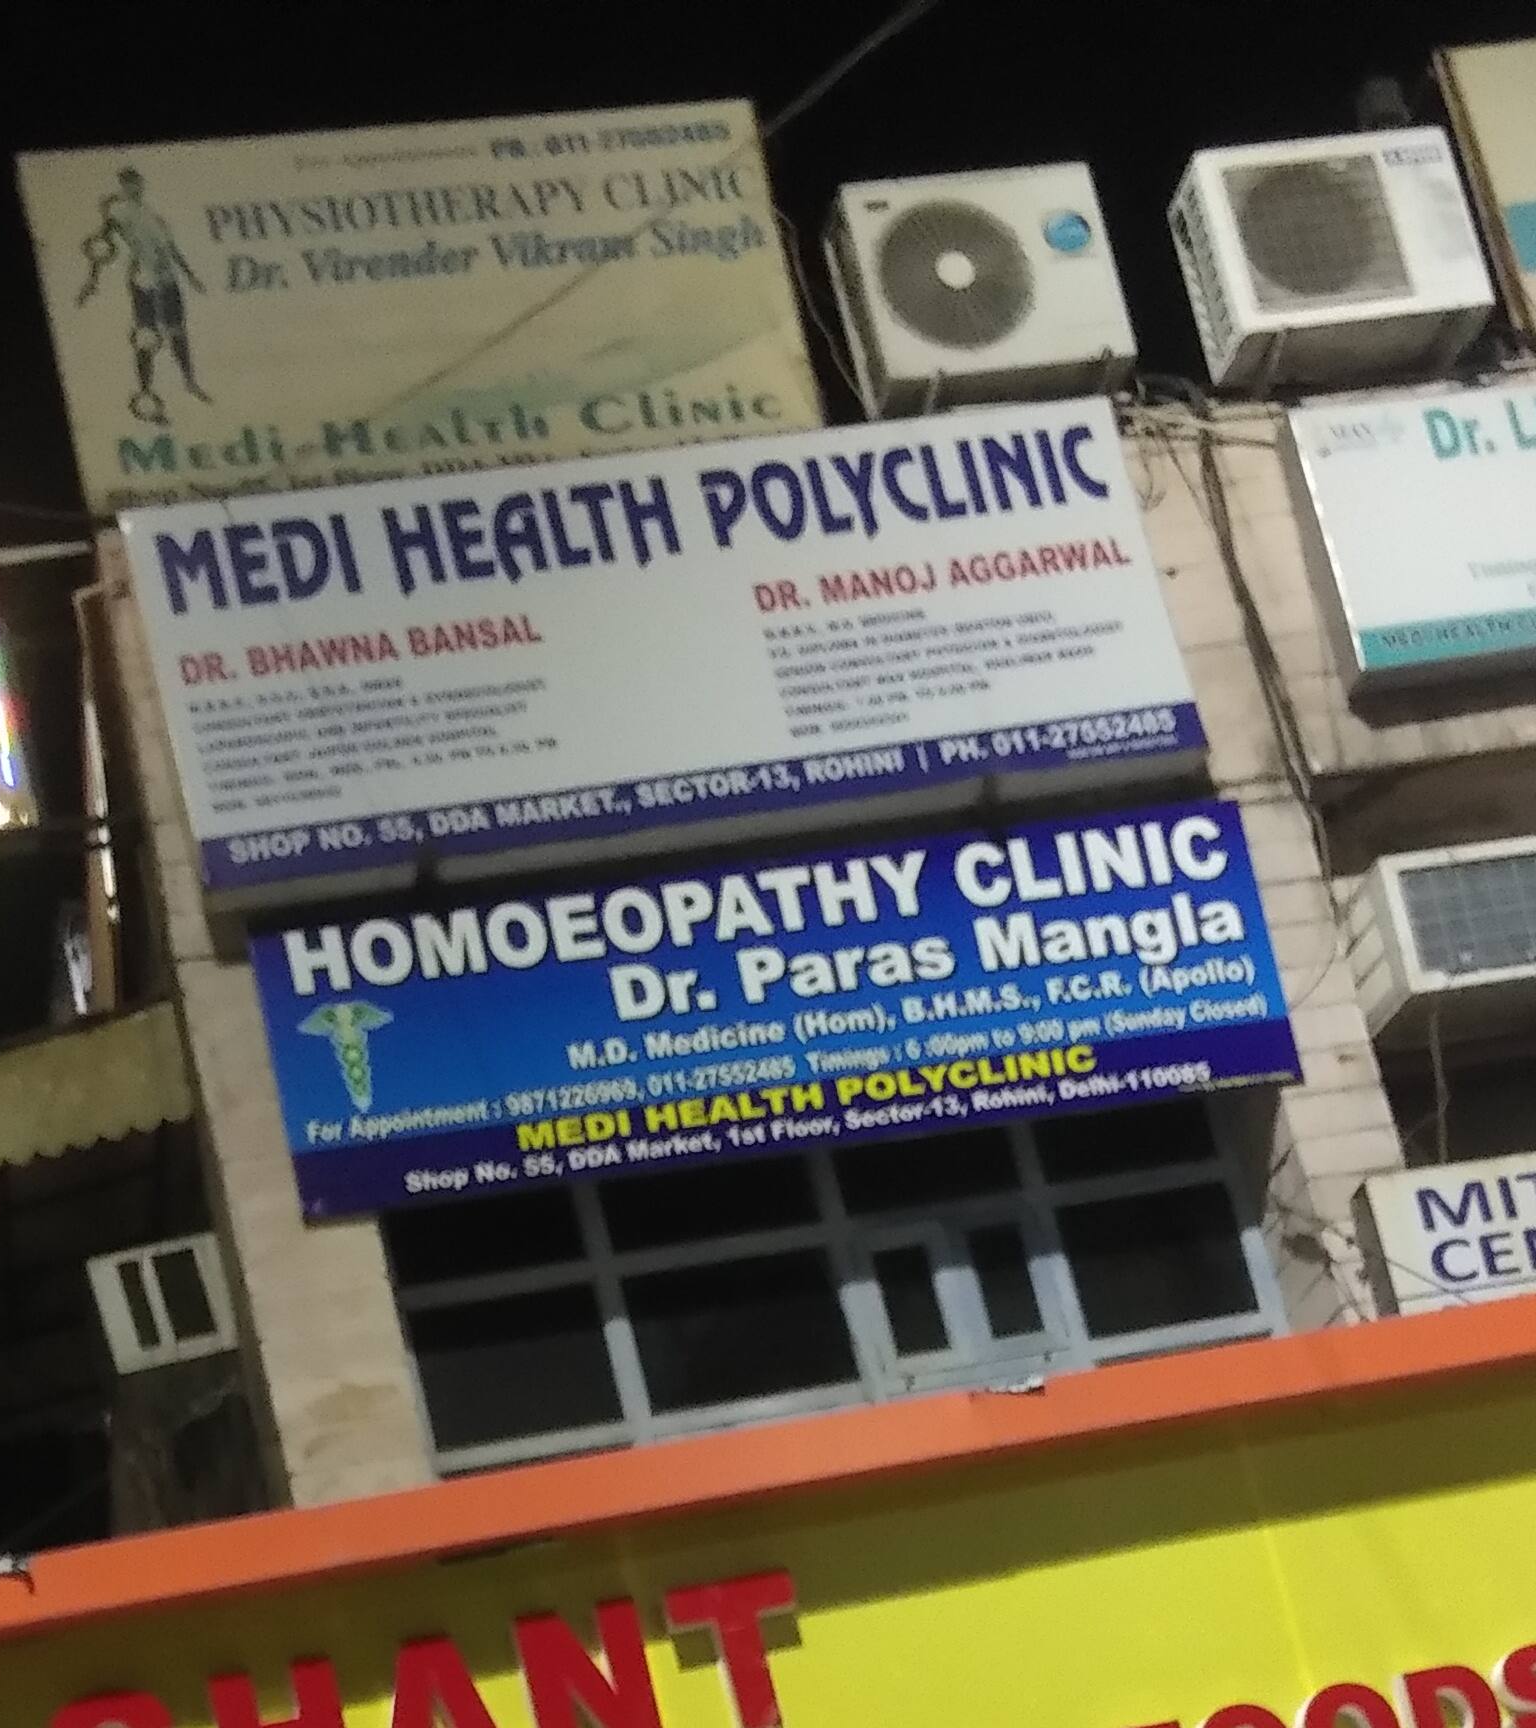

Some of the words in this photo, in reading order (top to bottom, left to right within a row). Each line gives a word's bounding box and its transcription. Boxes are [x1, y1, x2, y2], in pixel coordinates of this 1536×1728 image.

[205, 174, 586, 244] PHYSIOTHERAPY
[601, 164, 744, 209] CLINIC
[226, 253, 289, 294] Dr.
[301, 240, 479, 286] Virender
[490, 229, 637, 270] Vikram
[649, 211, 765, 262] Singh
[579, 382, 784, 437] Clinic
[1424, 406, 1496, 460] Dr.
[155, 513, 362, 615] MEDI
[383, 476, 683, 597] HEALTH
[699, 425, 1109, 549] POLYCLINIC
[752, 578, 812, 614] DR.
[819, 561, 938, 604] MANOJ
[948, 535, 1133, 588] AGGARWAL
[177, 650, 237, 686] DR.
[244, 632, 400, 678] BHAWNA
[407, 613, 544, 658] BANSAL
[228, 828, 311, 865] SHOP
[317, 819, 373, 852] NO.
[426, 800, 492, 837] DDA
[634, 760, 802, 809] SECTOR-13,
[804, 750, 905, 784] ROHINI
[938, 736, 988, 766] PH.
[283, 850, 926, 996] HOMOEOPATHY
[954, 815, 1227, 907] CLINIC
[608, 962, 716, 1022] Dr.
[736, 936, 955, 1004] Paras
[972, 891, 1244, 972] Mangla
[568, 1036, 638, 1070] M.D.
[645, 1017, 785, 1060] Medicine
[794, 1003, 896, 1043] (Hom),
[1045, 973, 1132, 1003] F.C.R.
[1140, 956, 1255, 999] (Apollo)
[306, 1118, 342, 1144] For
[348, 1099, 487, 1141] Appointment
[992, 1025, 1015, 1049] to
[515, 1109, 632, 1152] MEDI
[644, 1081, 823, 1134] HEALTH
[836, 1045, 1098, 1106] POLYCLINIC
[404, 1167, 468, 1195] Shop
[474, 1160, 519, 1184] No.
[569, 1145, 622, 1171] DDA
[626, 1131, 722, 1164] Market,
[729, 1123, 765, 1148] 1st
[770, 1117, 841, 1143] Floor,
[845, 1094, 968, 1130] Sector-13,
[971, 1085, 1056, 1113] Rohini,
